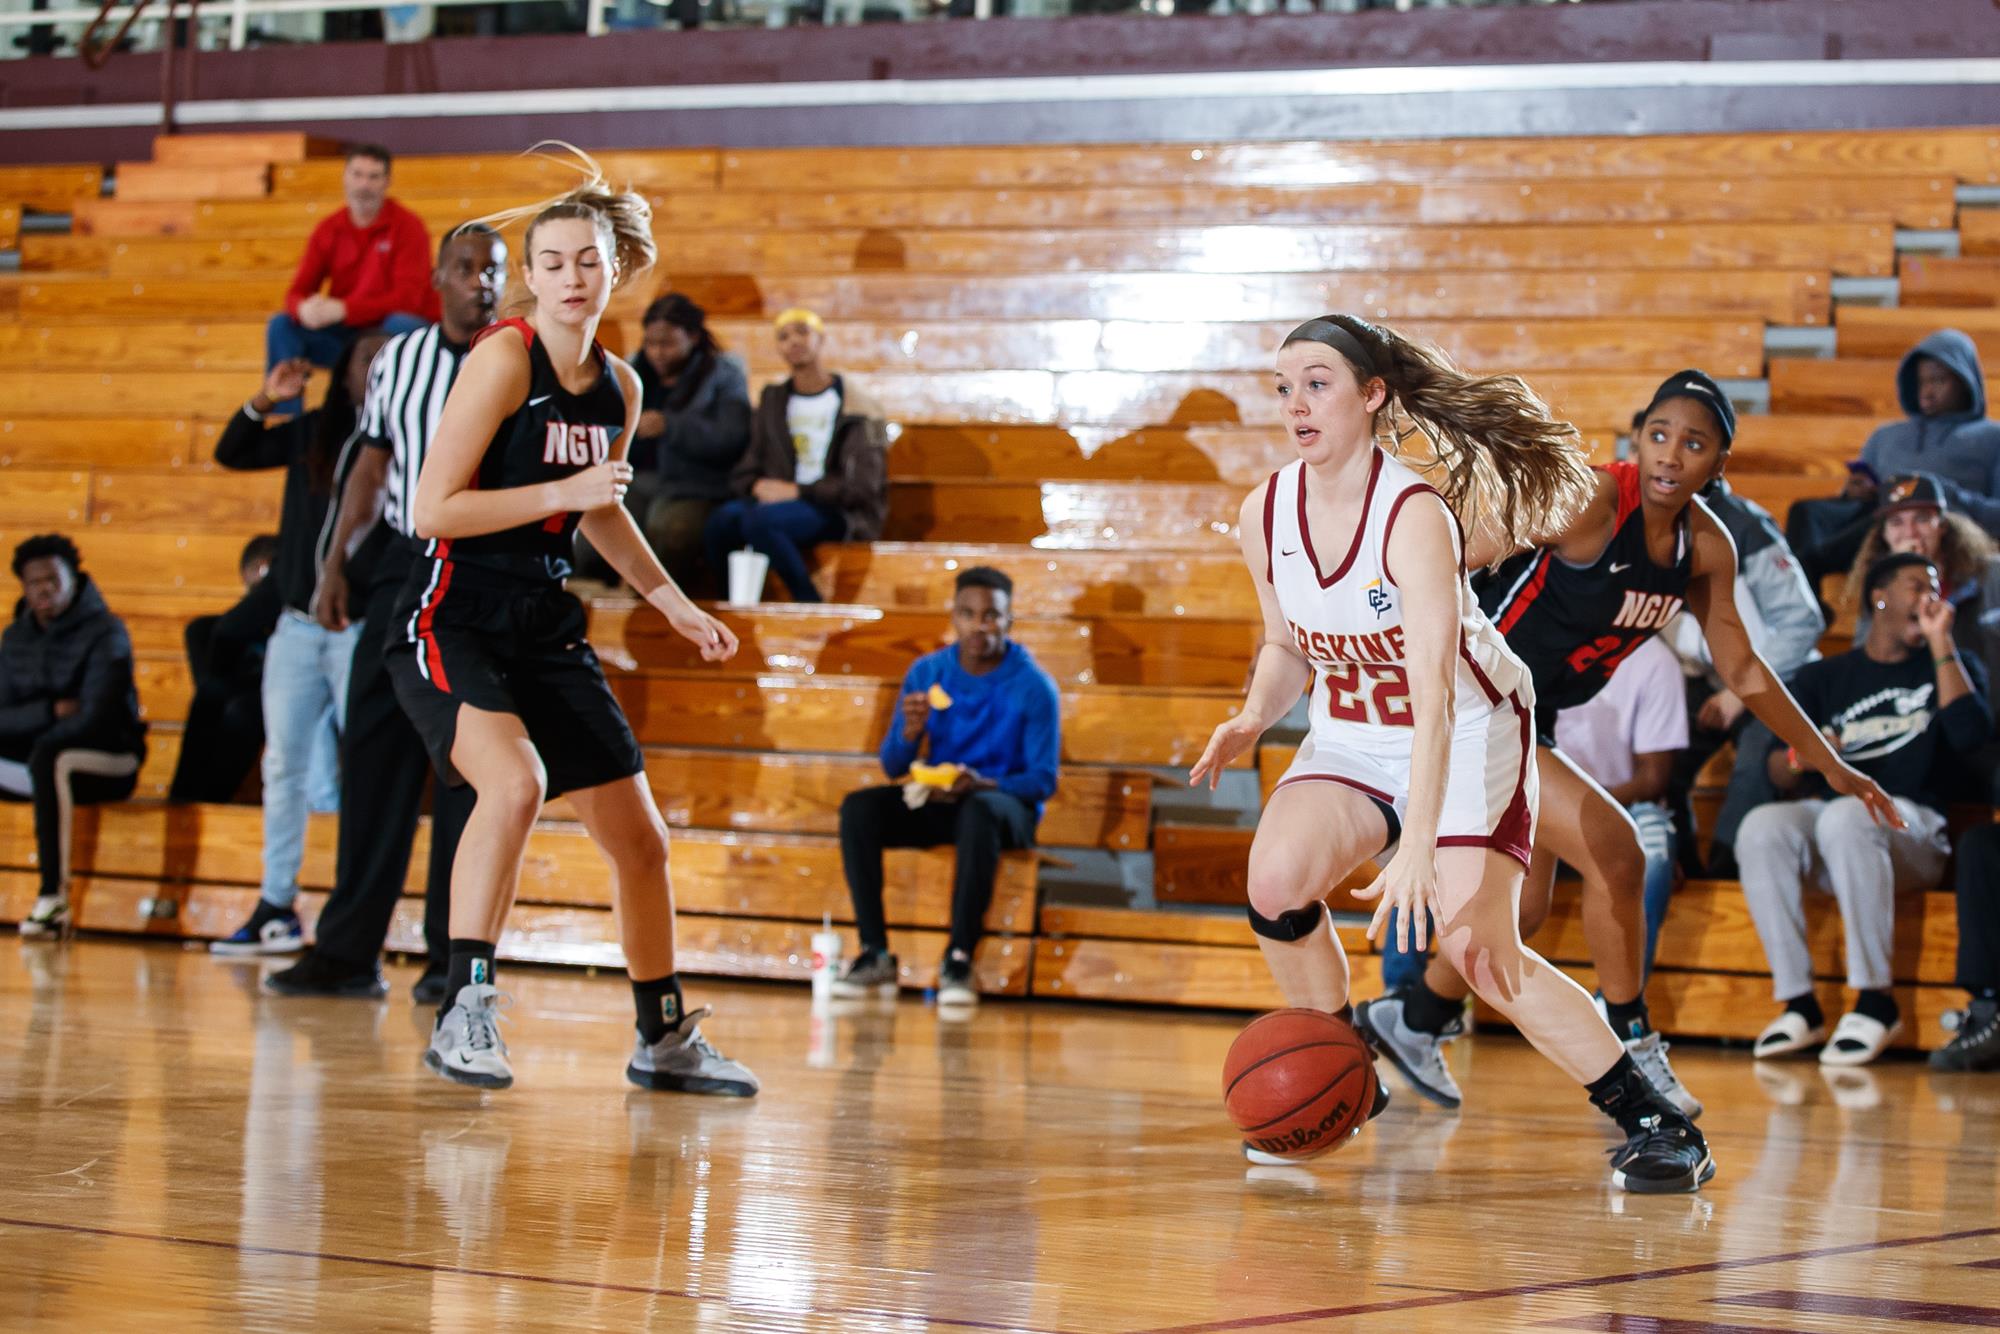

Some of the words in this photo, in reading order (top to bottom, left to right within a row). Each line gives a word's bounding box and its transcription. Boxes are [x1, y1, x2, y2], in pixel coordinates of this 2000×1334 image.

[543, 420, 610, 467] NGU
[1612, 589, 1683, 629] NGU
[1325, 662, 1415, 728] 22
[1255, 1100, 1351, 1153] Wilson
